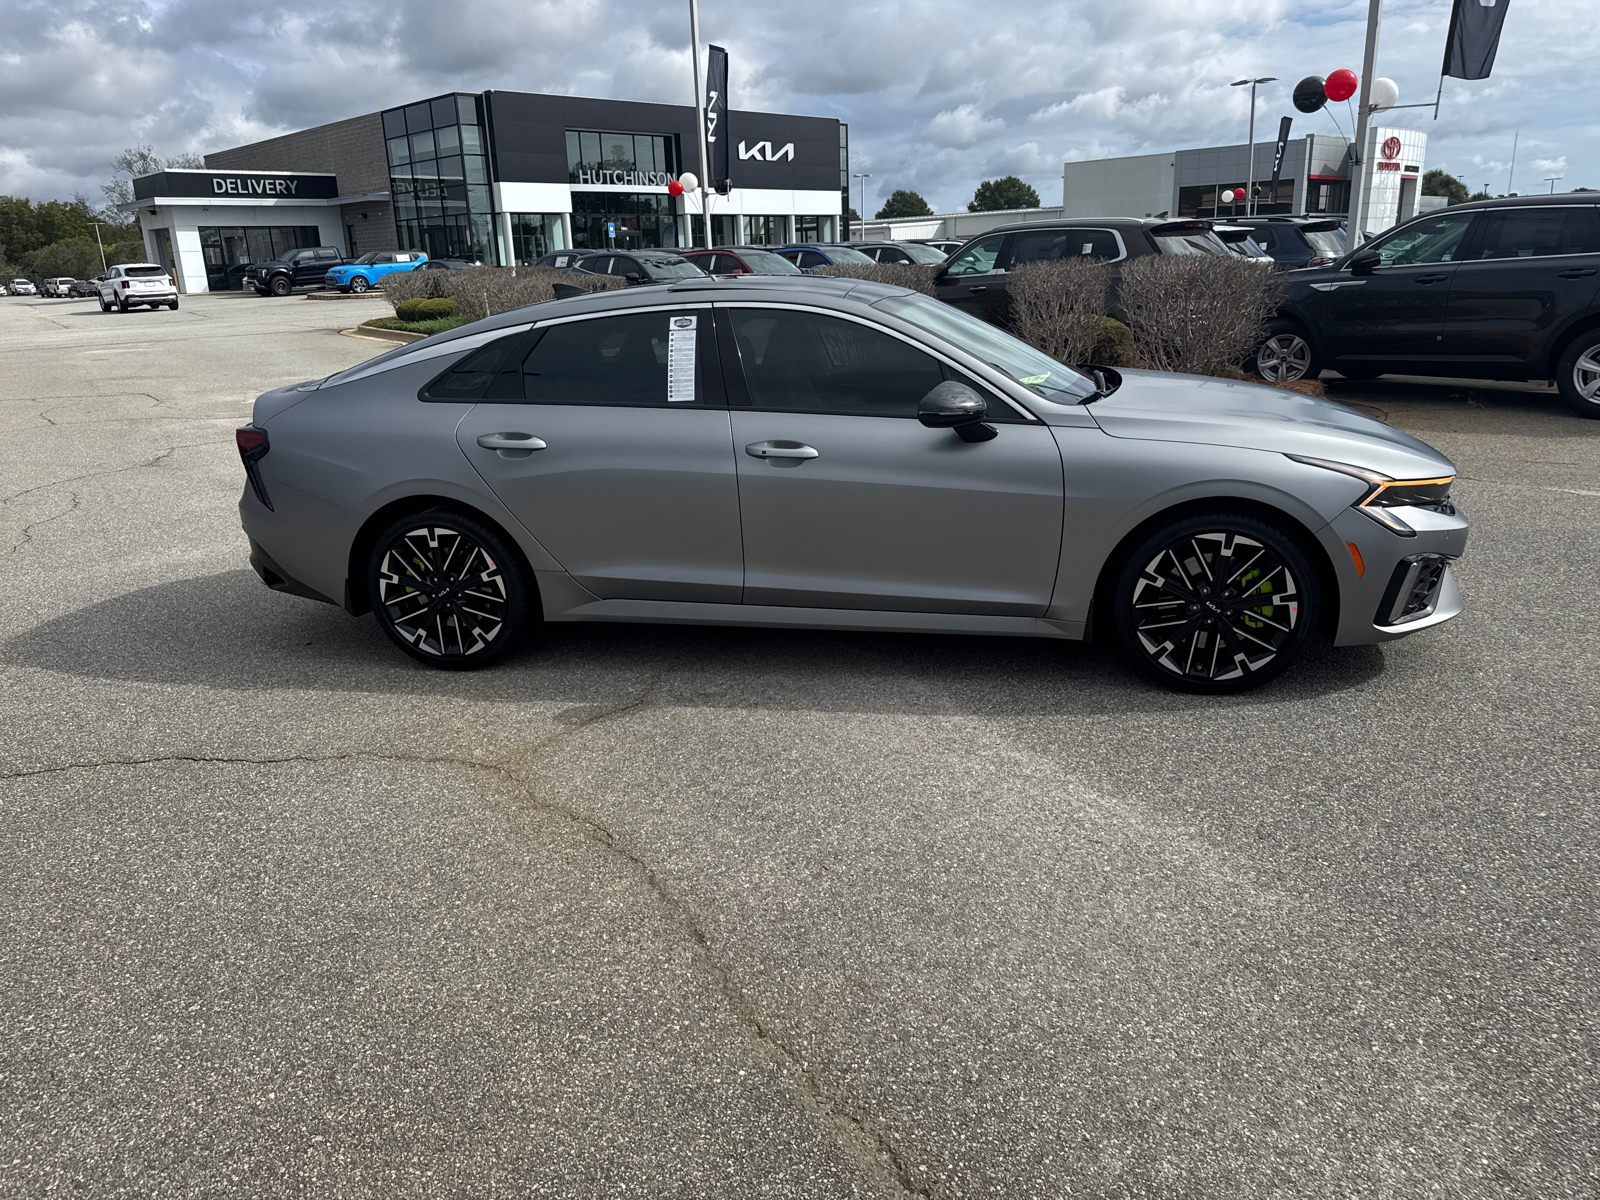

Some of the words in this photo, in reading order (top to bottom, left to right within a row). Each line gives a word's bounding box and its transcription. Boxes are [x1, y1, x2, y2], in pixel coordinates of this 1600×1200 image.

[738, 140, 795, 163] KIA
[212, 178, 298, 195] DELIVERY
[579, 169, 677, 187] HUTCHINSON
[1206, 601, 1221, 613] KIA
